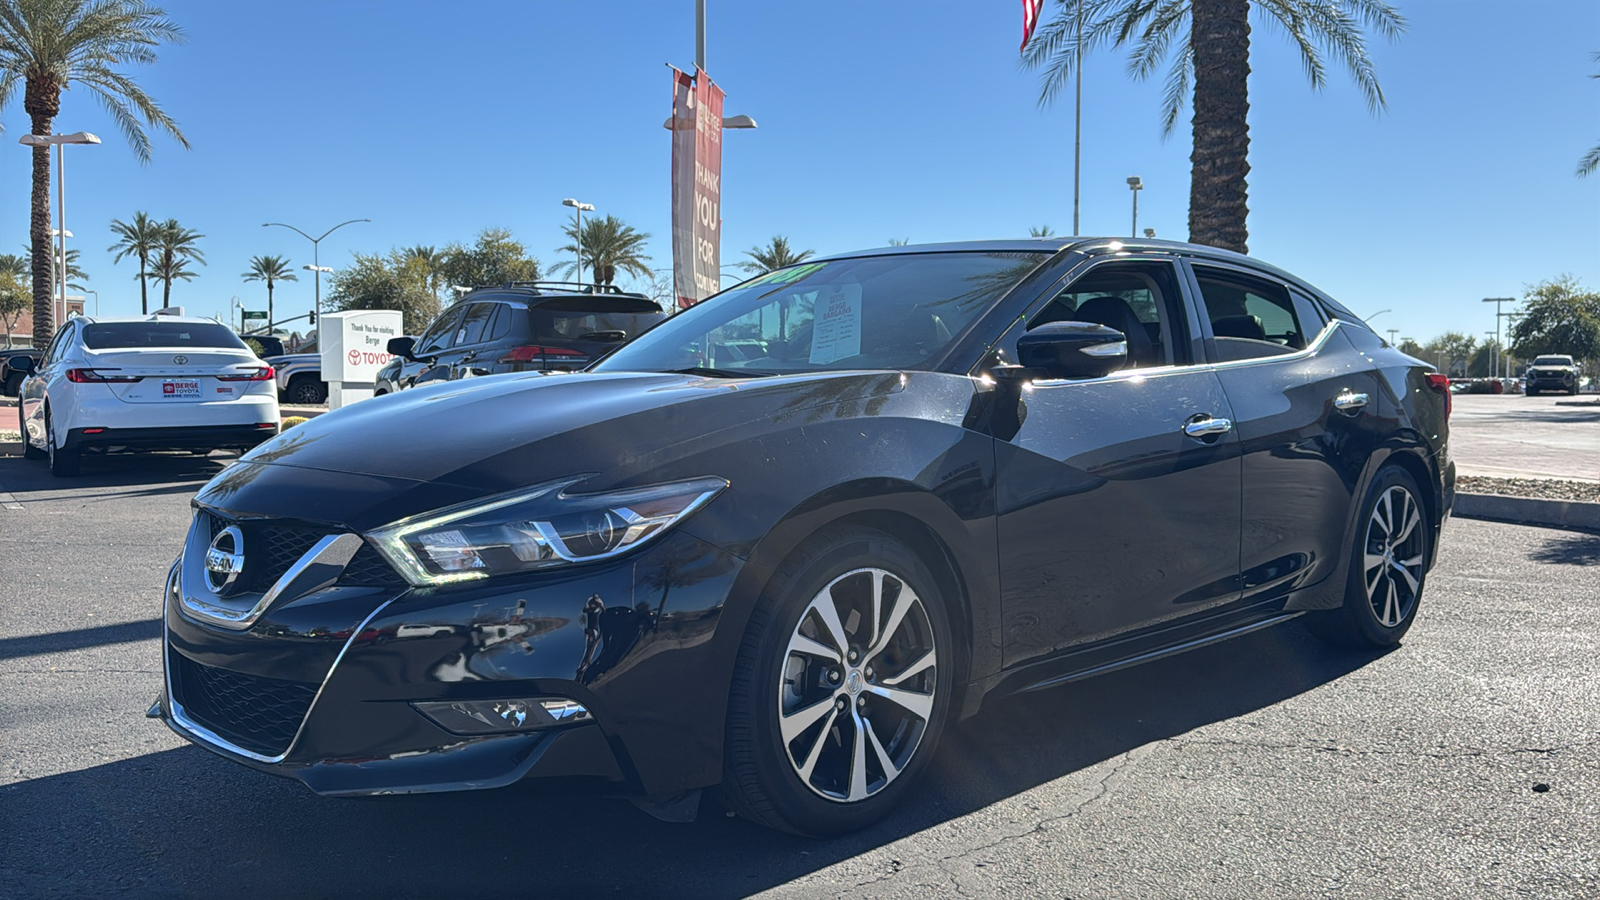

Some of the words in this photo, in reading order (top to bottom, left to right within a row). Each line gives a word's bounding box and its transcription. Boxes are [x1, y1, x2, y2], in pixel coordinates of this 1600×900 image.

[696, 160, 719, 192] THANK
[696, 191, 717, 231] YOU
[698, 237, 714, 266] FOR
[822, 306, 852, 320] BARGAINS
[351, 323, 363, 332] Thank
[364, 324, 372, 333] You
[379, 325, 395, 336] visiting
[365, 335, 380, 347] Berge
[362, 352, 396, 365] TOYOT
